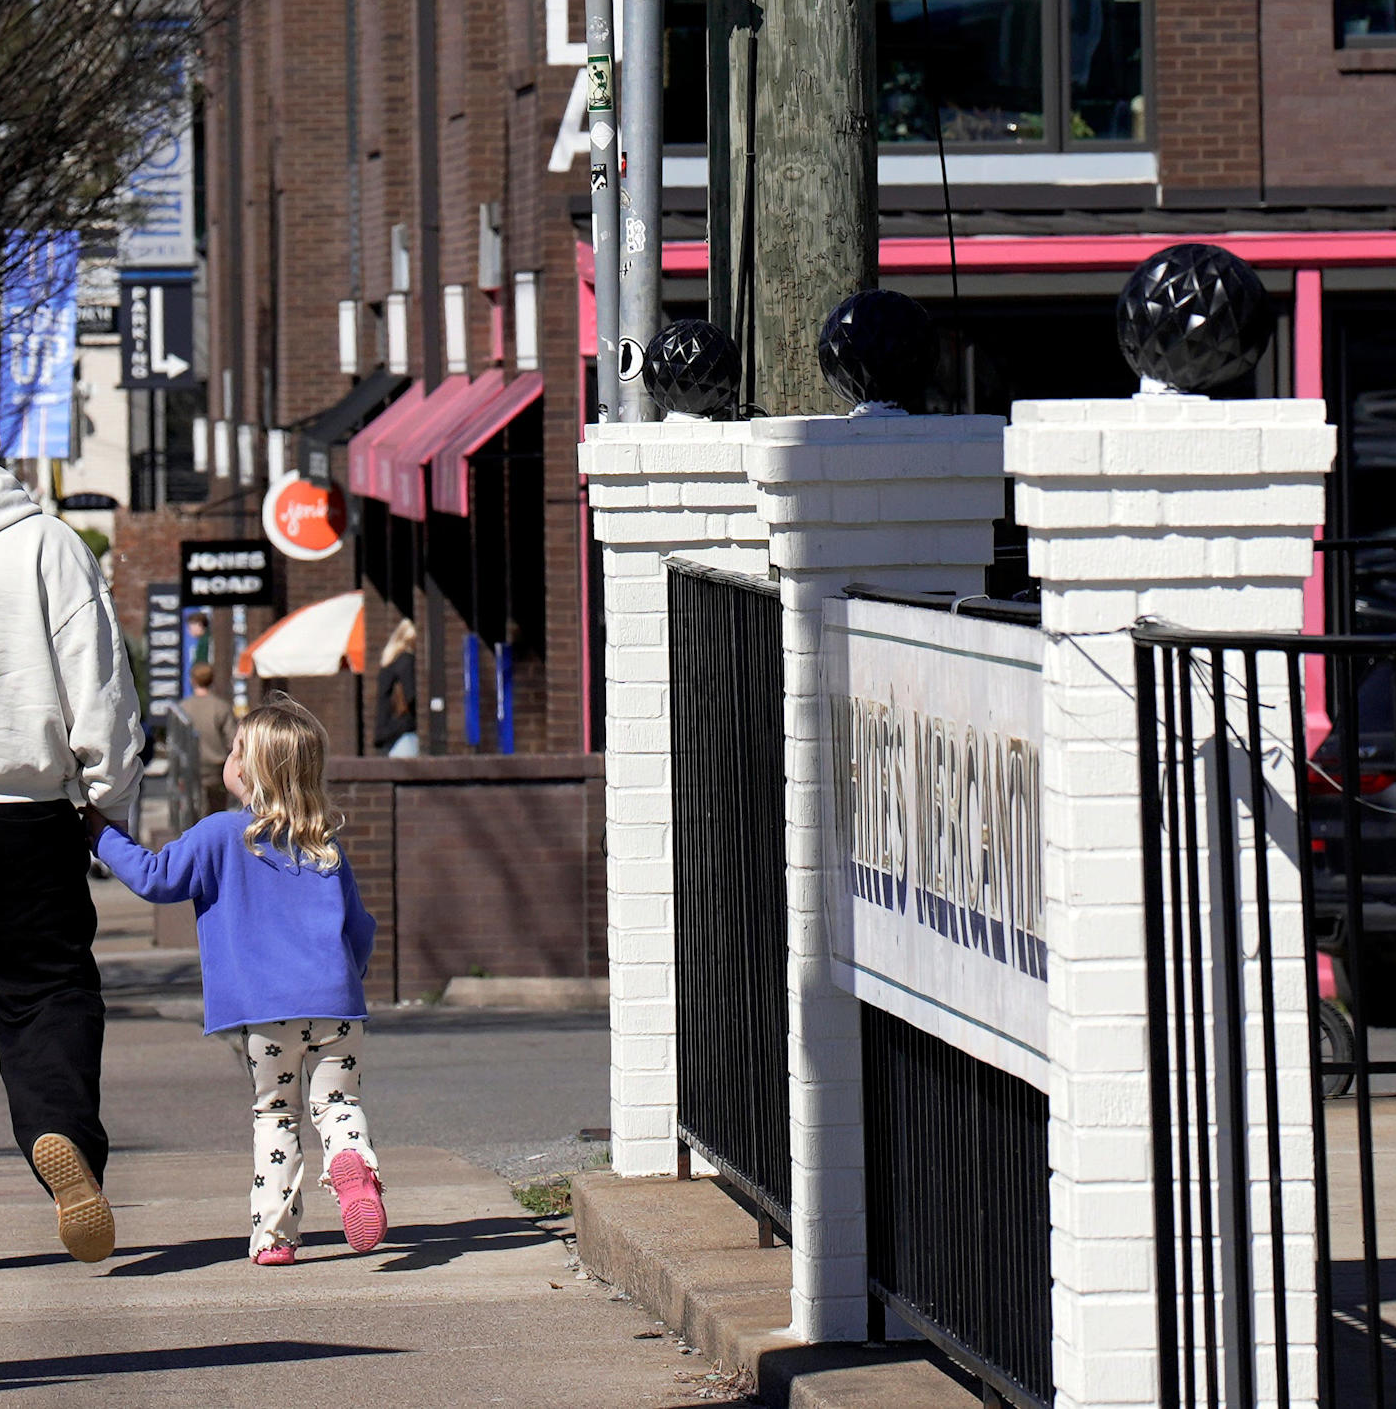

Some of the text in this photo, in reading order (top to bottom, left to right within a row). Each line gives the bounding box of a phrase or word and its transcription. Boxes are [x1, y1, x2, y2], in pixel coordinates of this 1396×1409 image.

[131, 286, 149, 379] PARKING
[187, 551, 266, 571] JONES
[191, 576, 263, 595] ROAD
[150, 594, 181, 717] PARKING
[830, 690, 1048, 982] WHITE'S MERCANTIL
